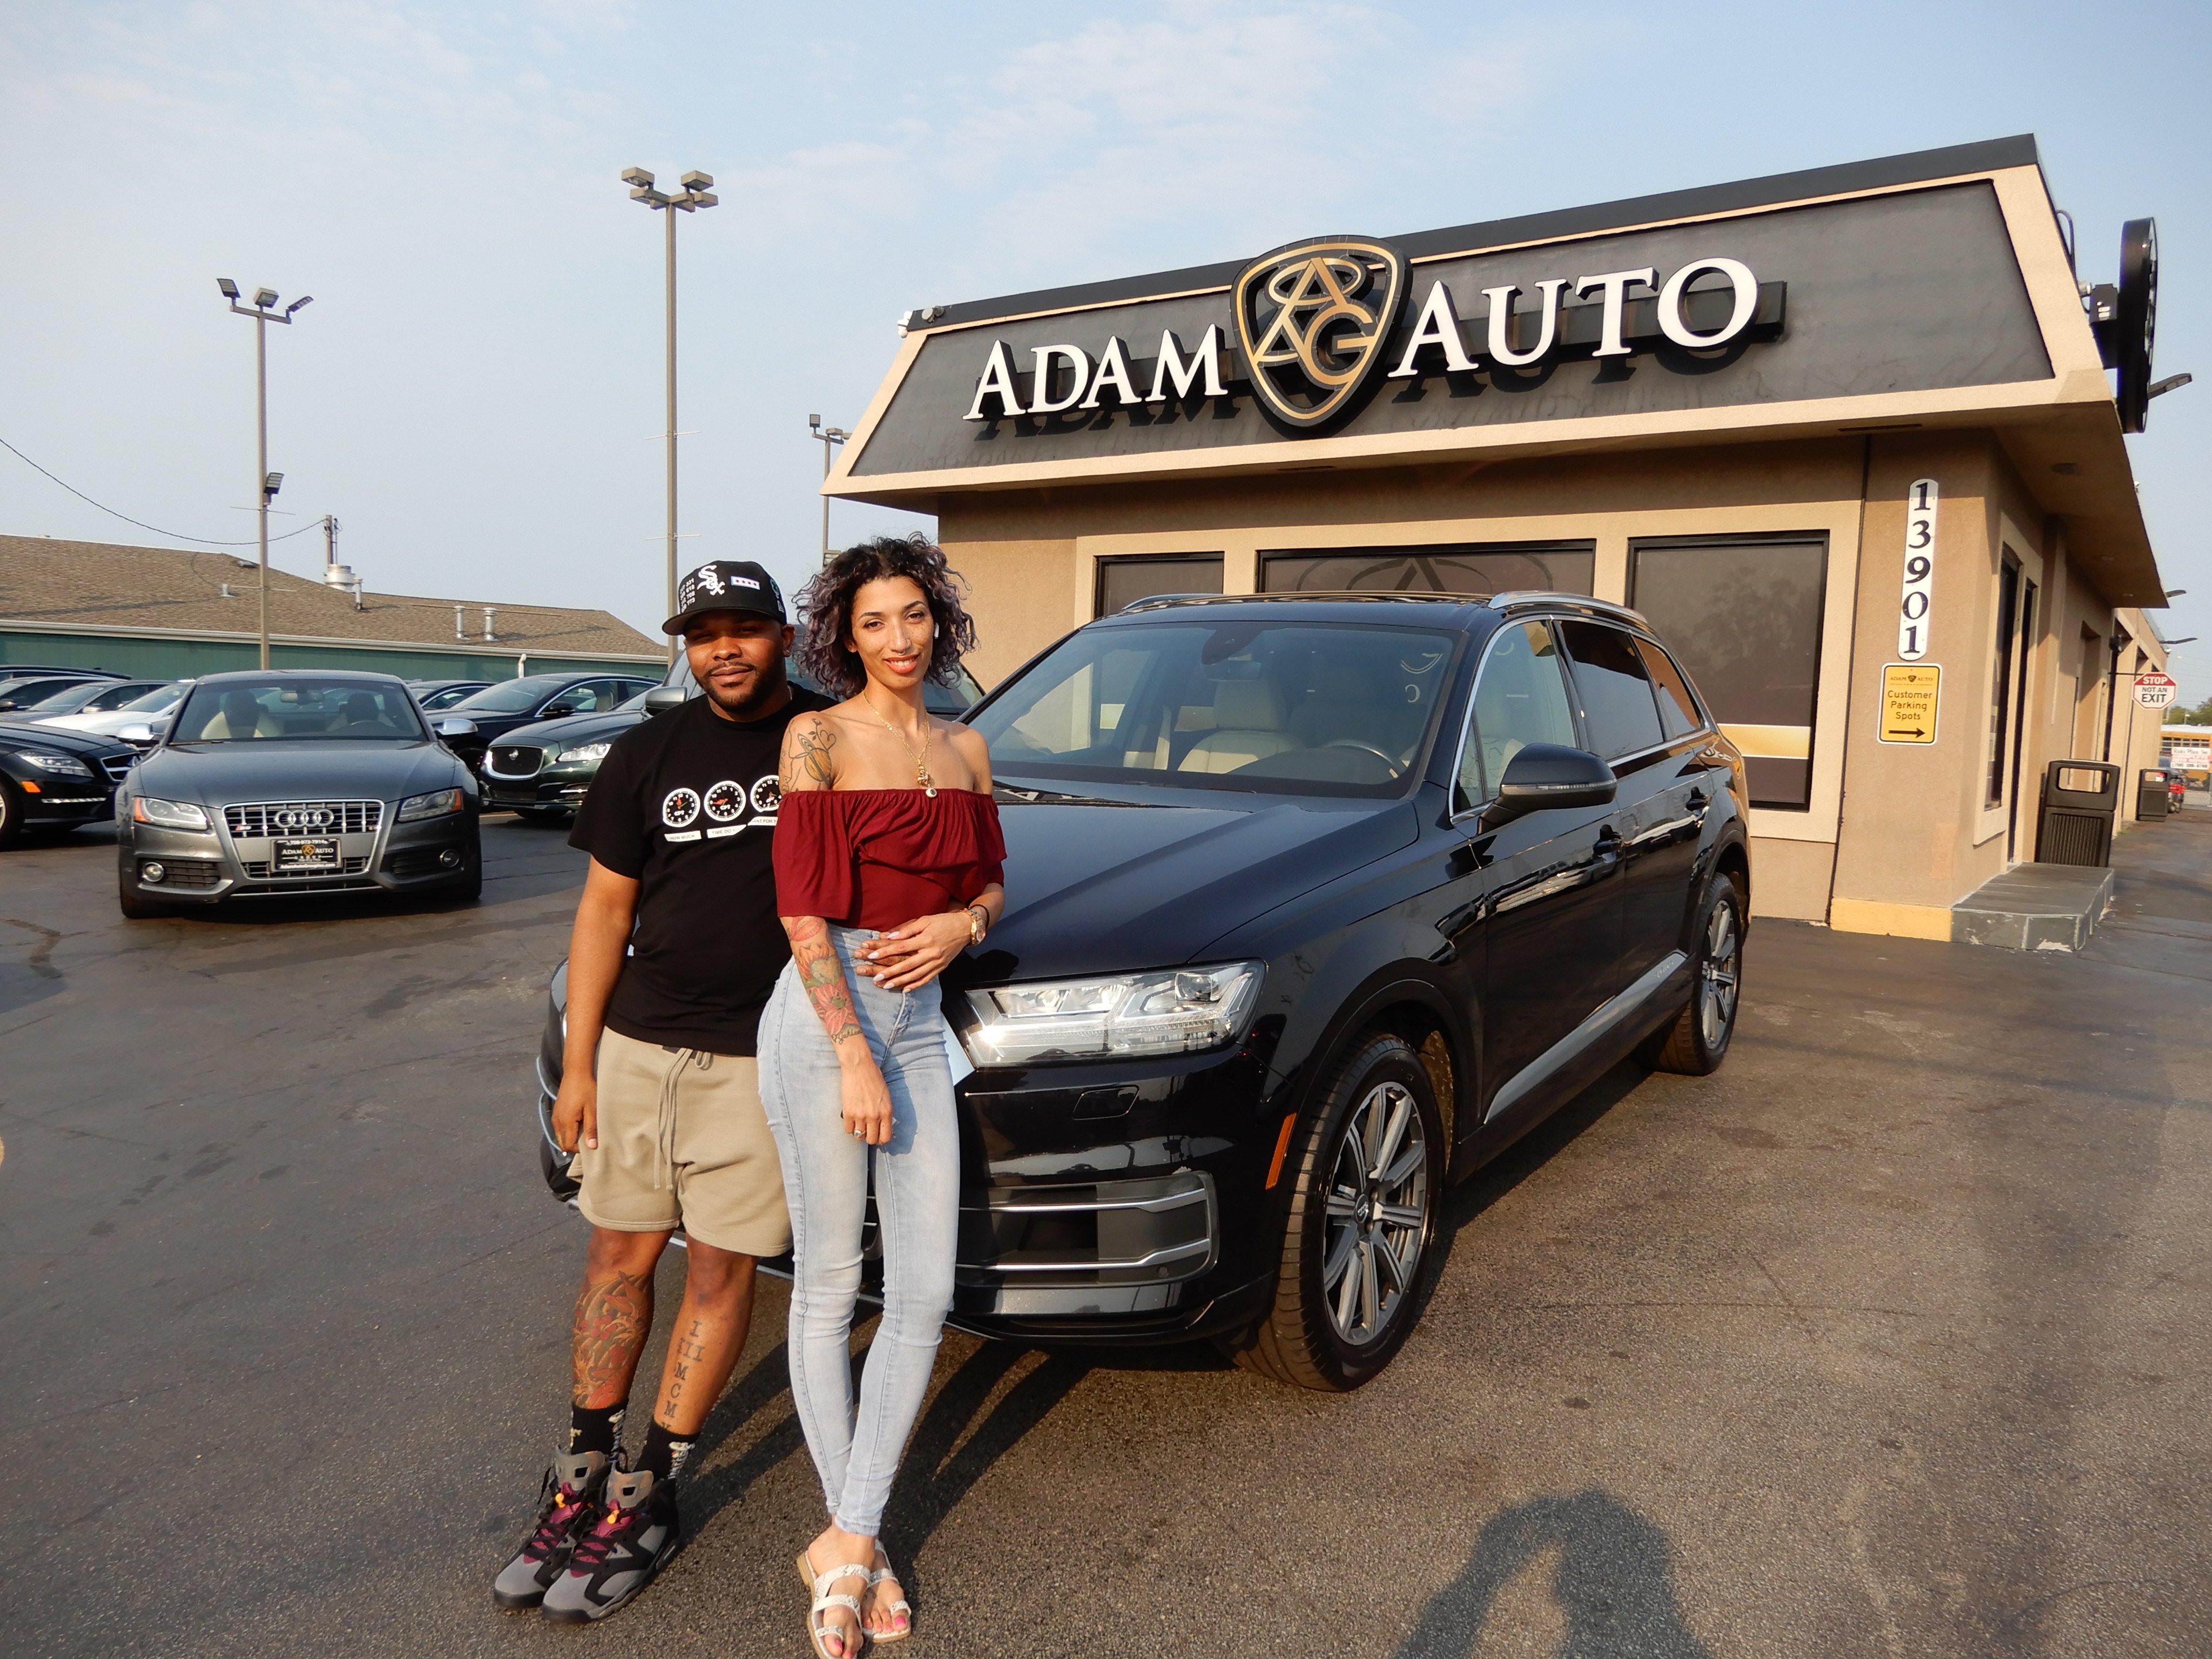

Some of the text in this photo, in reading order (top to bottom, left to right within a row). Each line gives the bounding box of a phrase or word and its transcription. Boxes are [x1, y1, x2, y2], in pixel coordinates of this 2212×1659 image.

[962, 324, 1228, 421] ADAM
[1388, 258, 1761, 378] AUTO
[1902, 482, 1931, 654] 13901
[697, 565, 725, 596] Sox
[2142, 676, 2168, 684] STOP
[1887, 690, 1932, 699] Customer
[2142, 693, 2167, 702] EXIT
[1891, 701, 1927, 712] Parking
[1896, 711, 1920, 721] Spots
